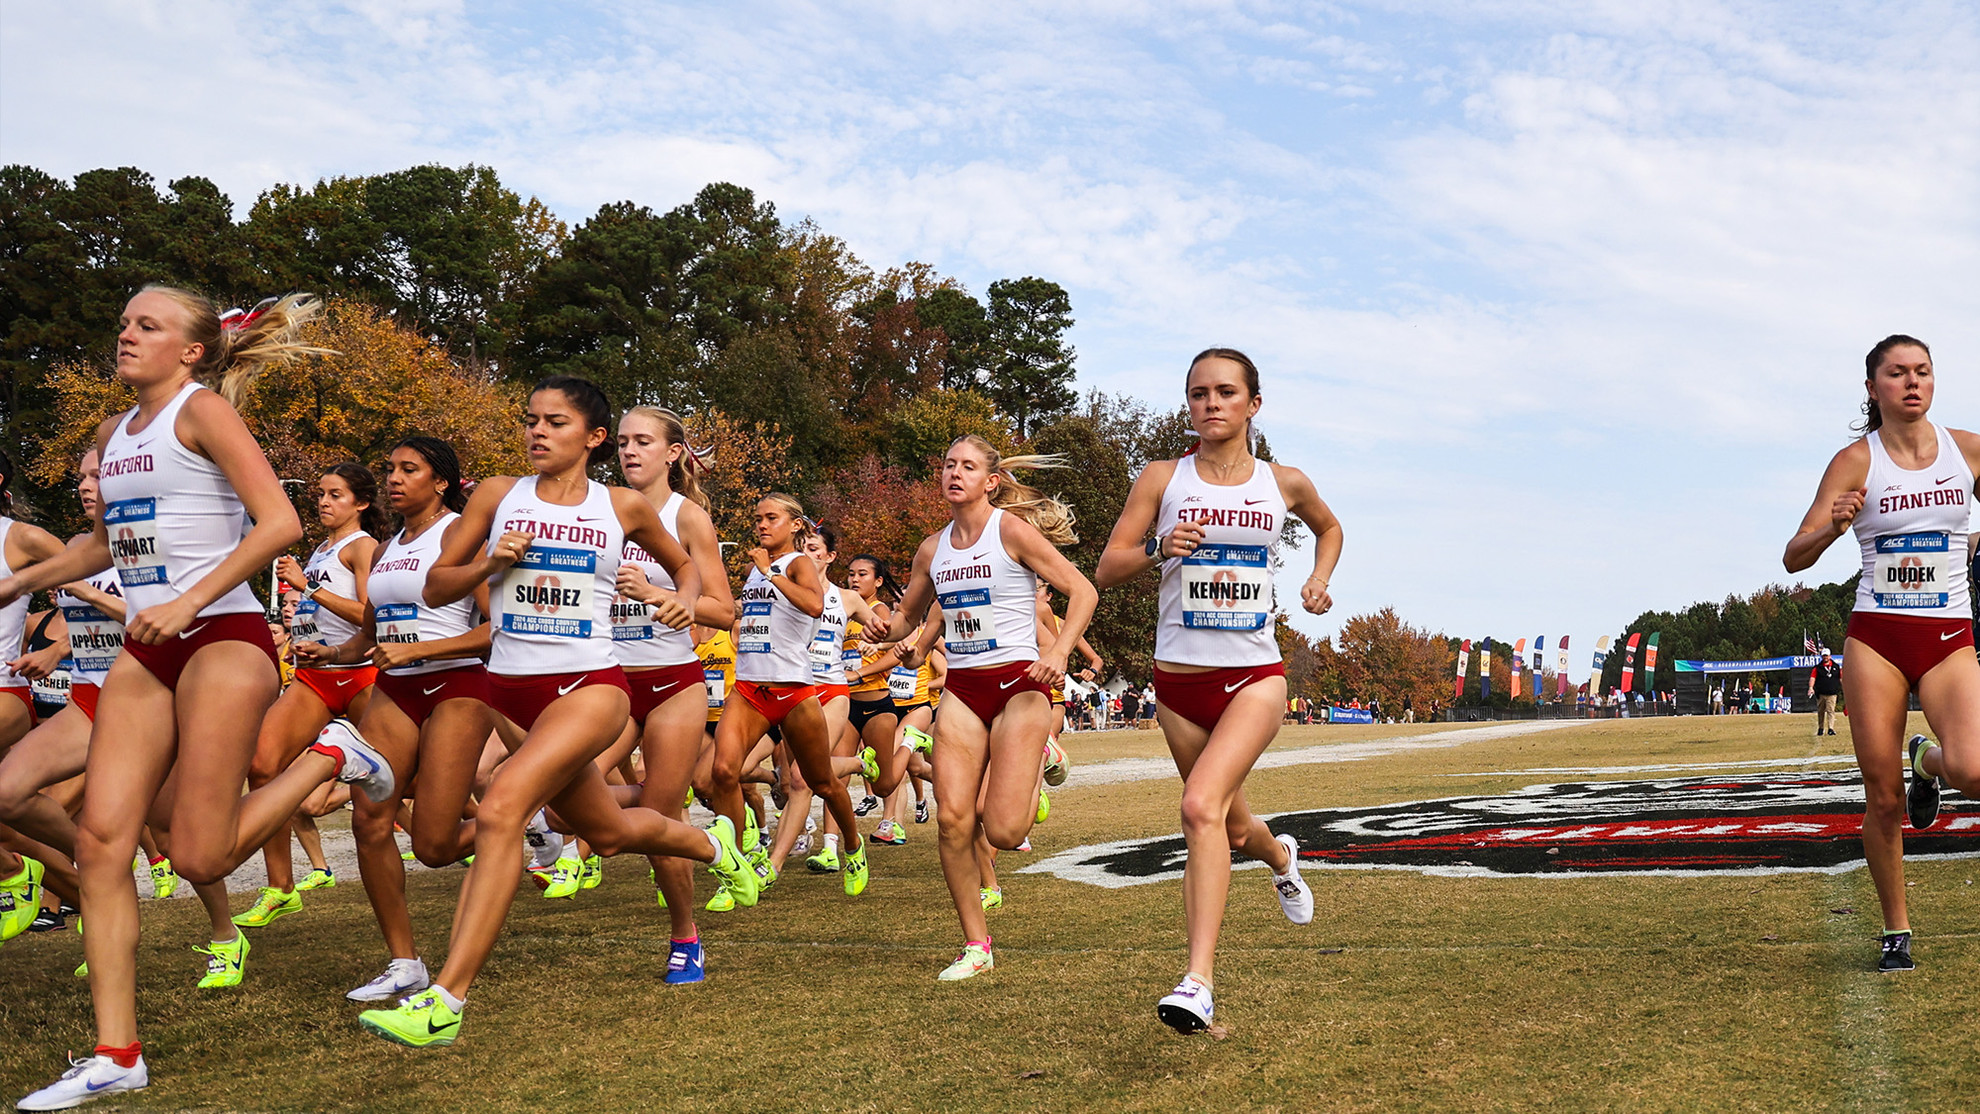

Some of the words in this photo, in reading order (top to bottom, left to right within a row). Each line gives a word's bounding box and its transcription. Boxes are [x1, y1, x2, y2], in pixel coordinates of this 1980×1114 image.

[100, 454, 154, 479] TANFORD
[1880, 489, 1964, 514] STANFORD
[1178, 508, 1273, 531] STANFORD
[503, 519, 607, 550] STANFORD
[112, 537, 155, 558] STEWART
[1882, 537, 1906, 548] ACC
[523, 552, 543, 563] CC
[1189, 549, 1220, 560] ACC
[1226, 553, 1260, 561] GREATNESS
[550, 557, 588, 567] GREATNESS
[936, 564, 992, 585] STANFORD
[1887, 566, 1935, 582] DUDEK
[516, 584, 581, 607] SUAREZ
[741, 587, 778, 600] RGINIA
[1189, 581, 1261, 600] KENNEDY
[944, 596, 957, 605] ACC
[1882, 598, 1940, 606] CHAMPIONSHIPS
[512, 621, 580, 635] CHAMPIONSHIPS
[954, 618, 981, 633] FLYNN
[1193, 618, 1257, 627] CHAMPIONSHIPS
[72, 633, 123, 648] APPLETON
[1793, 656, 1821, 667] START
